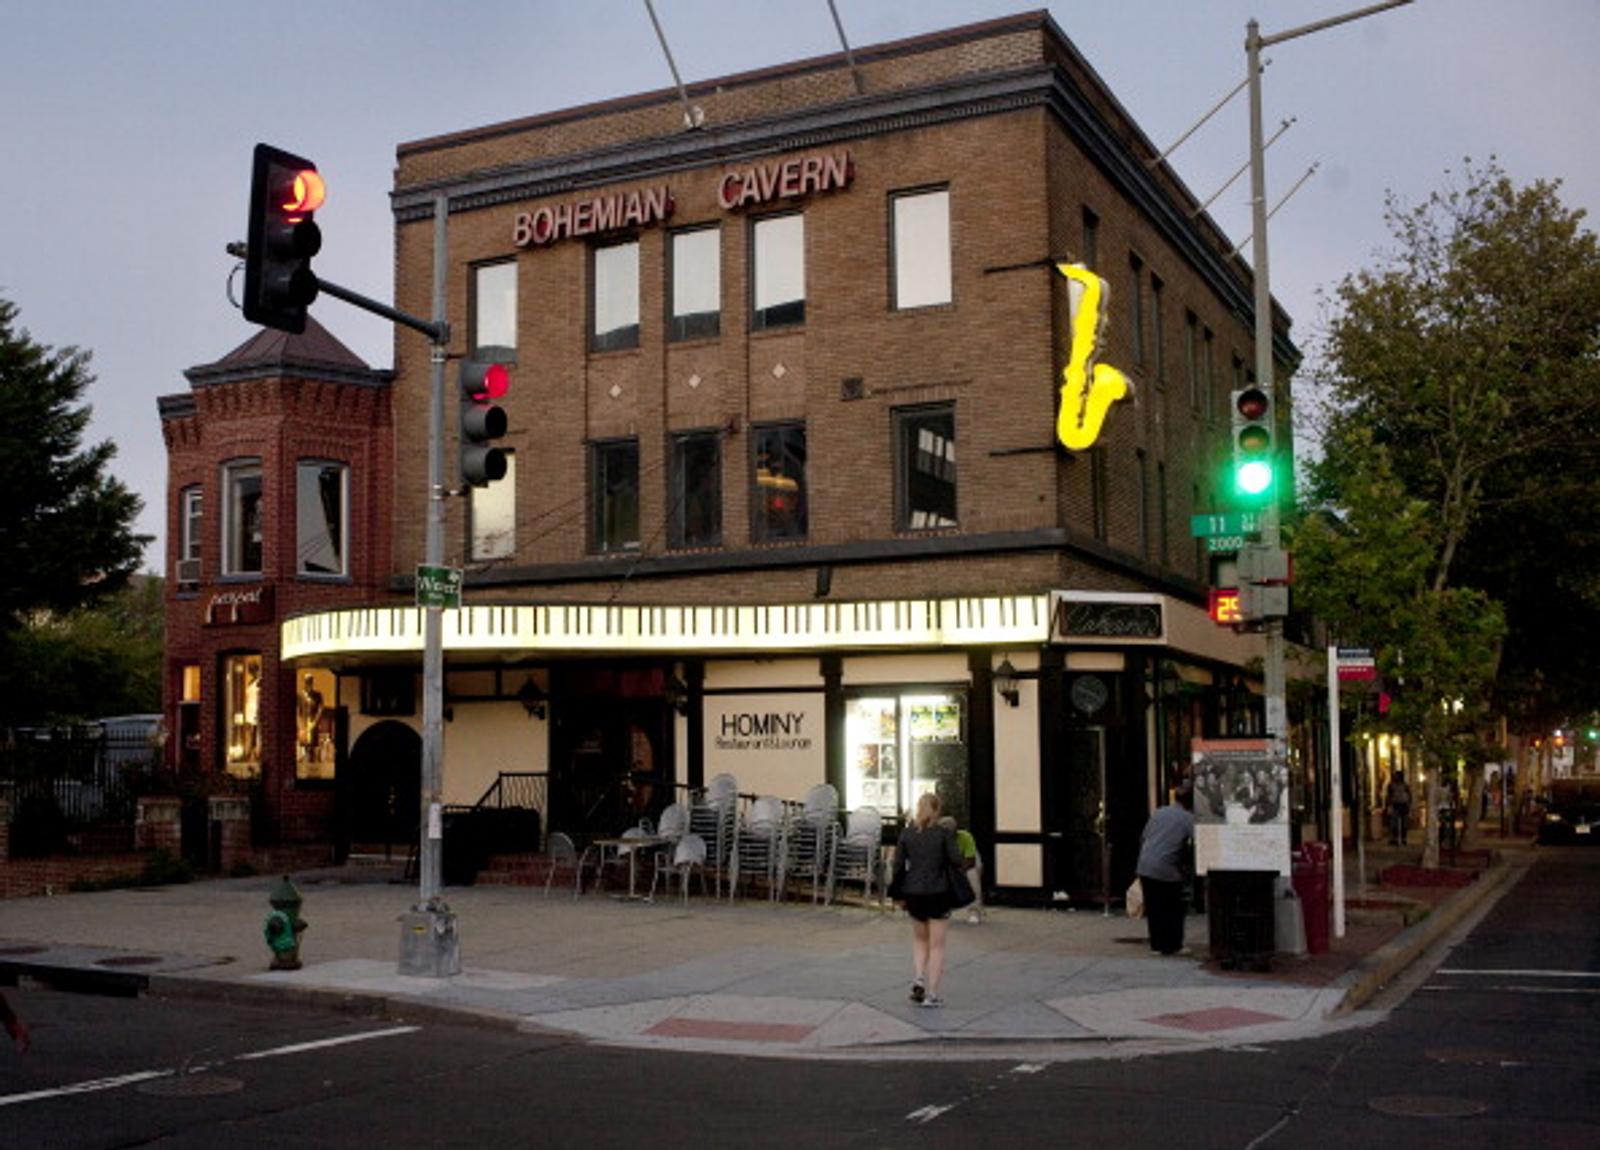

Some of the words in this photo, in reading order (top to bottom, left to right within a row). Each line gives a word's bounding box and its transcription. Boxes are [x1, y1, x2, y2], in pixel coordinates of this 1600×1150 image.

[512, 186, 670, 247] BOHEMIAN
[716, 152, 850, 209] CAVERN
[721, 711, 805, 736] HOMINY
